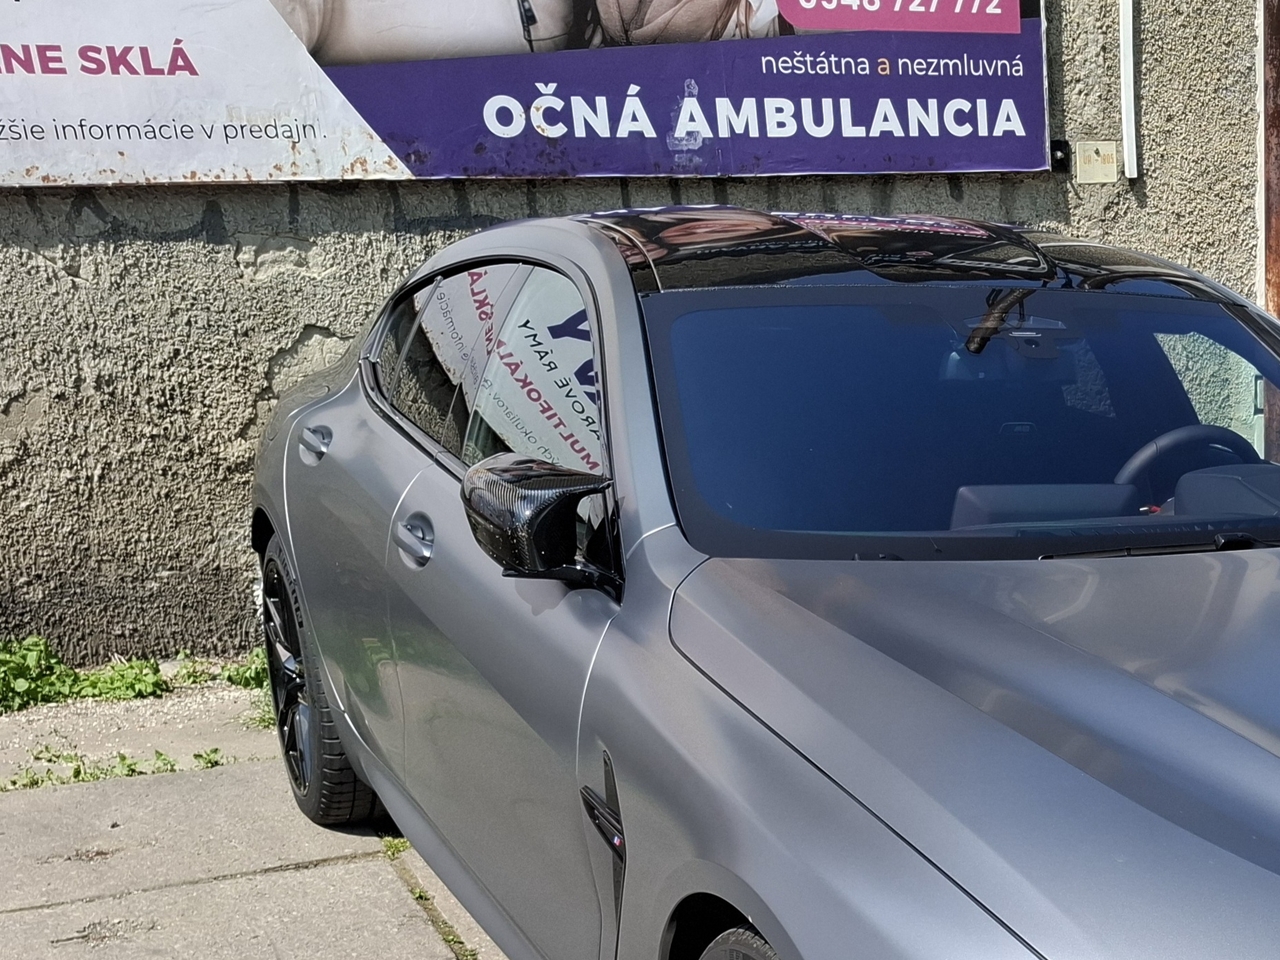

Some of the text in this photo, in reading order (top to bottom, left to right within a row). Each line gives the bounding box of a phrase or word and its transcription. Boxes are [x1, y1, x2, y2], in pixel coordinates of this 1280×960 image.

[0, 38, 200, 76] NE SKLÁ
[760, 51, 1024, 77] neštátna a nezmluvná
[482, 82, 1026, 139] OČNÁ AMBULANCIA
[52, 118, 194, 141] informácie
[200, 124, 215, 140] v
